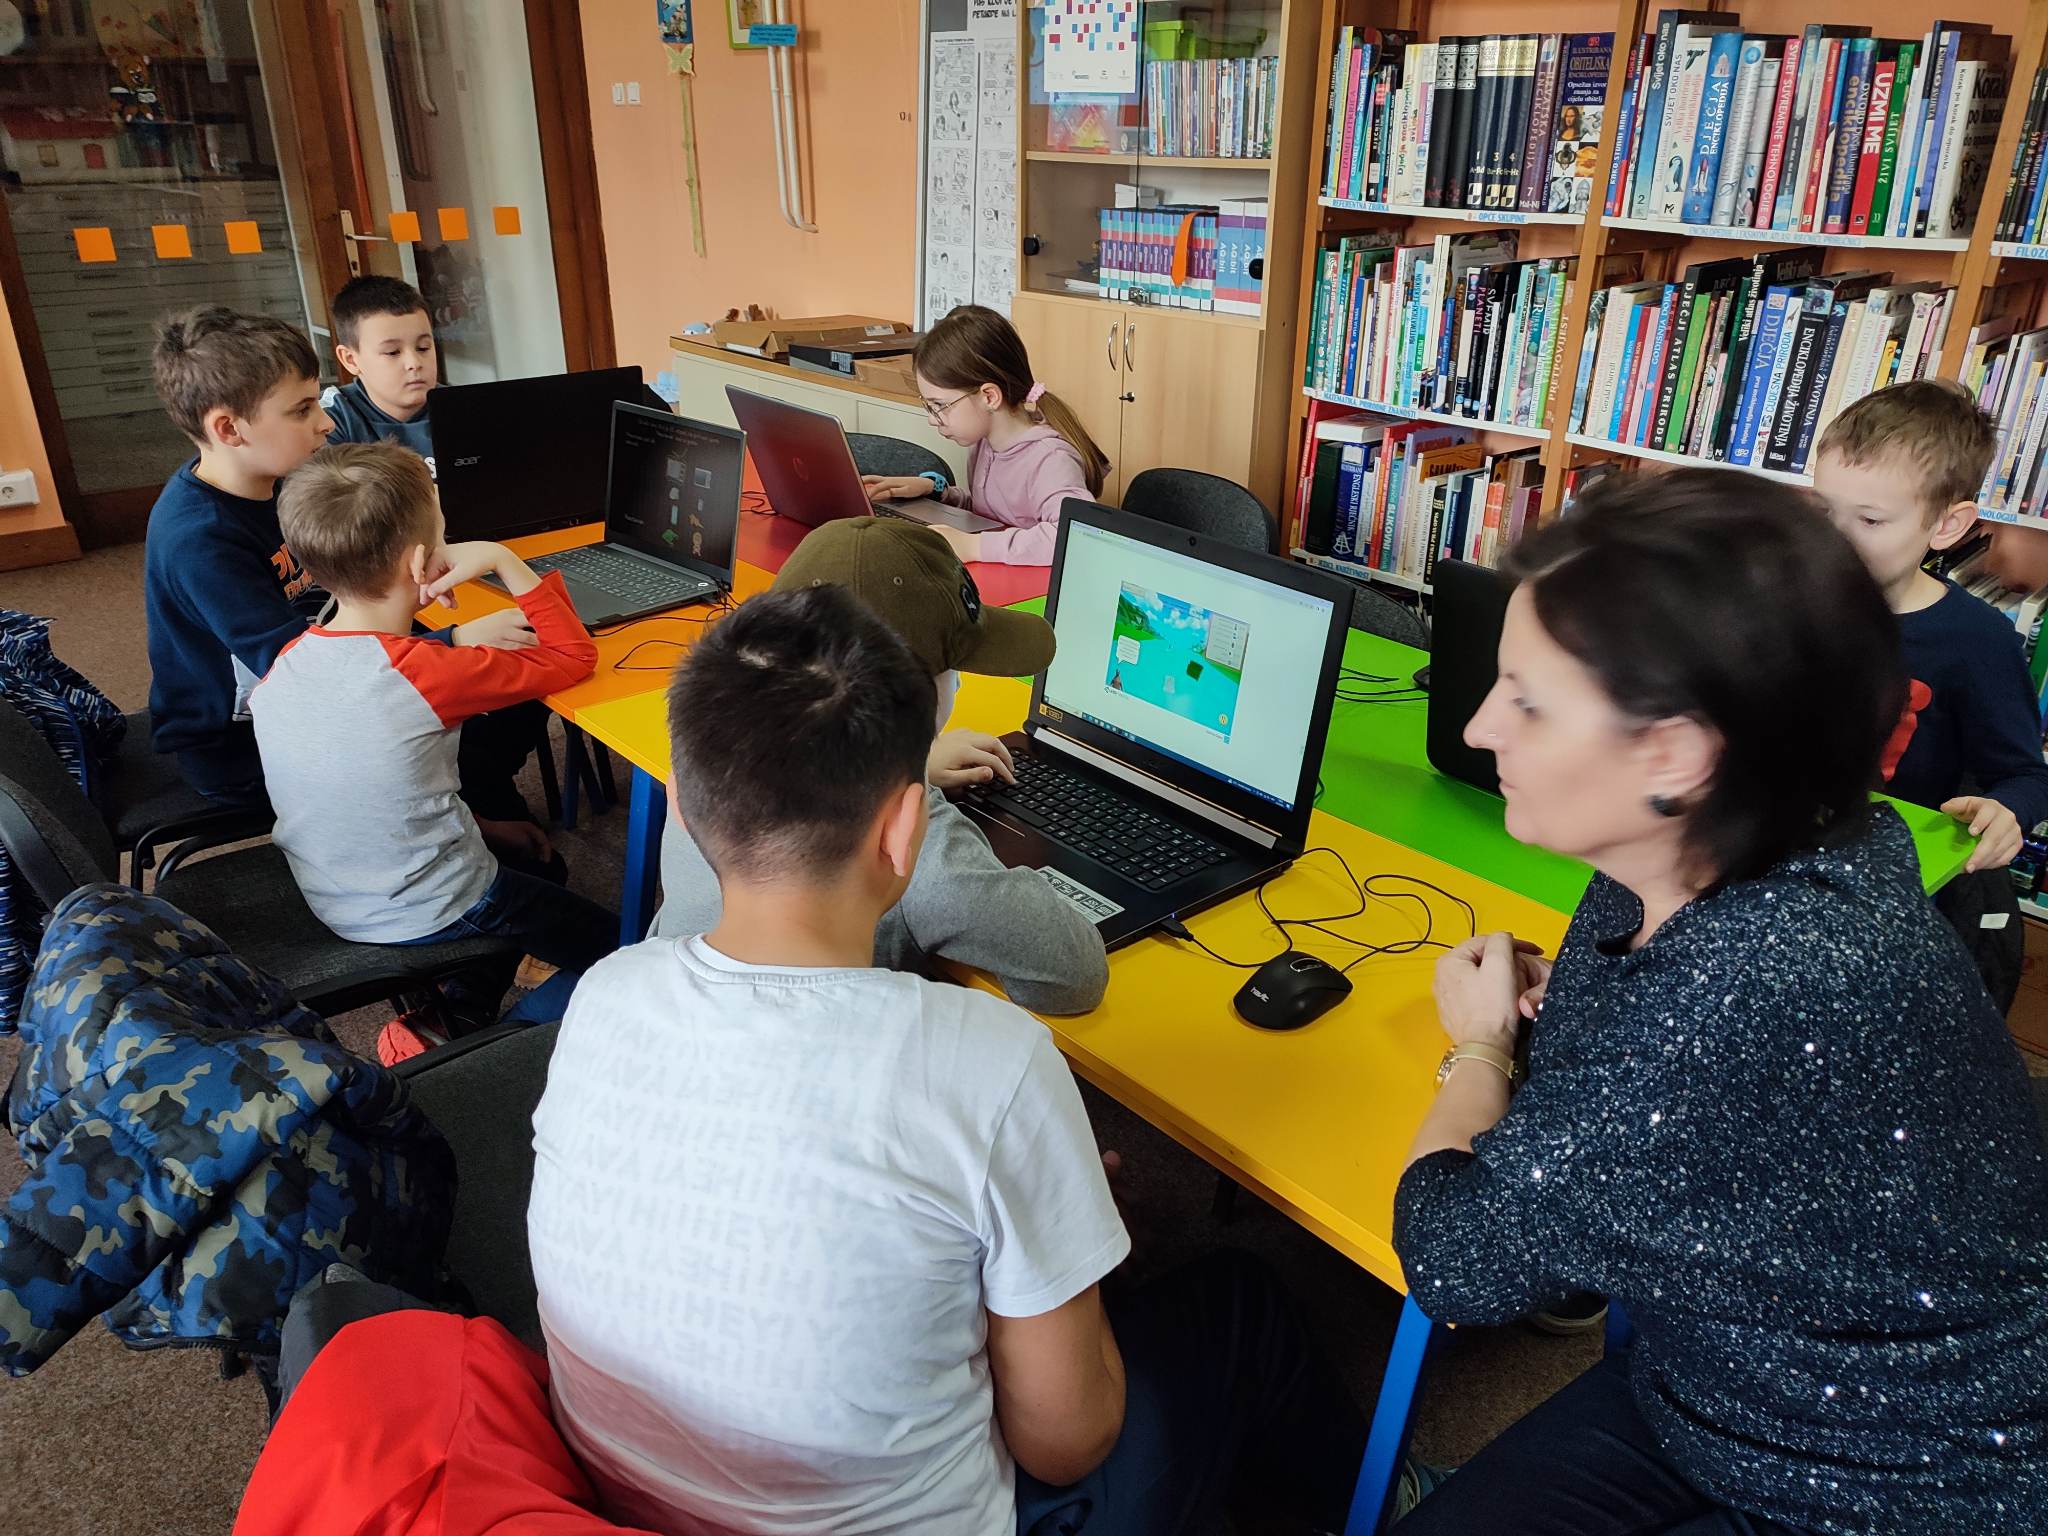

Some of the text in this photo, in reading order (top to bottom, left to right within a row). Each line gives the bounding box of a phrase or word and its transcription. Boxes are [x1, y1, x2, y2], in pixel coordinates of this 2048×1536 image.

[1651, 22, 1671, 90] Svijet oko nas
[1664, 53, 1683, 127] SVIJET OKO NAS
[1696, 79, 1722, 155] DJEČJA
[1709, 81, 1730, 156] ENCIKLOPEDIJA
[1773, 79, 1792, 141] SUVREMENE
[1869, 70, 1892, 123] UZMI
[1829, 74, 1861, 203] enciklopedija
[1863, 126, 1882, 155] ME
[1877, 111, 1899, 184] ŽIVI SVIJET
[1527, 186, 1534, 196] 7
[1637, 194, 1645, 205] 2
[1473, 286, 1486, 333] PLANETI
[1738, 263, 1765, 343] Veliki atlas životinja
[1548, 313, 1570, 401] PRETPOVIJEST
[1654, 281, 1695, 444] DJEČJI ATLAS PRIRODE
[1753, 312, 1784, 373] DJEČJA
[1775, 330, 1793, 370] PRIRODA
[1774, 325, 1816, 449] ENCIKLOPEDIJA ŽIVOTINJA
[1803, 372, 1828, 428] ŽIVOTINJA
[453, 455, 481, 467] acer
[1349, 473, 1362, 505] ENGLESKI
[1383, 503, 1396, 550] SLIKOVNI
